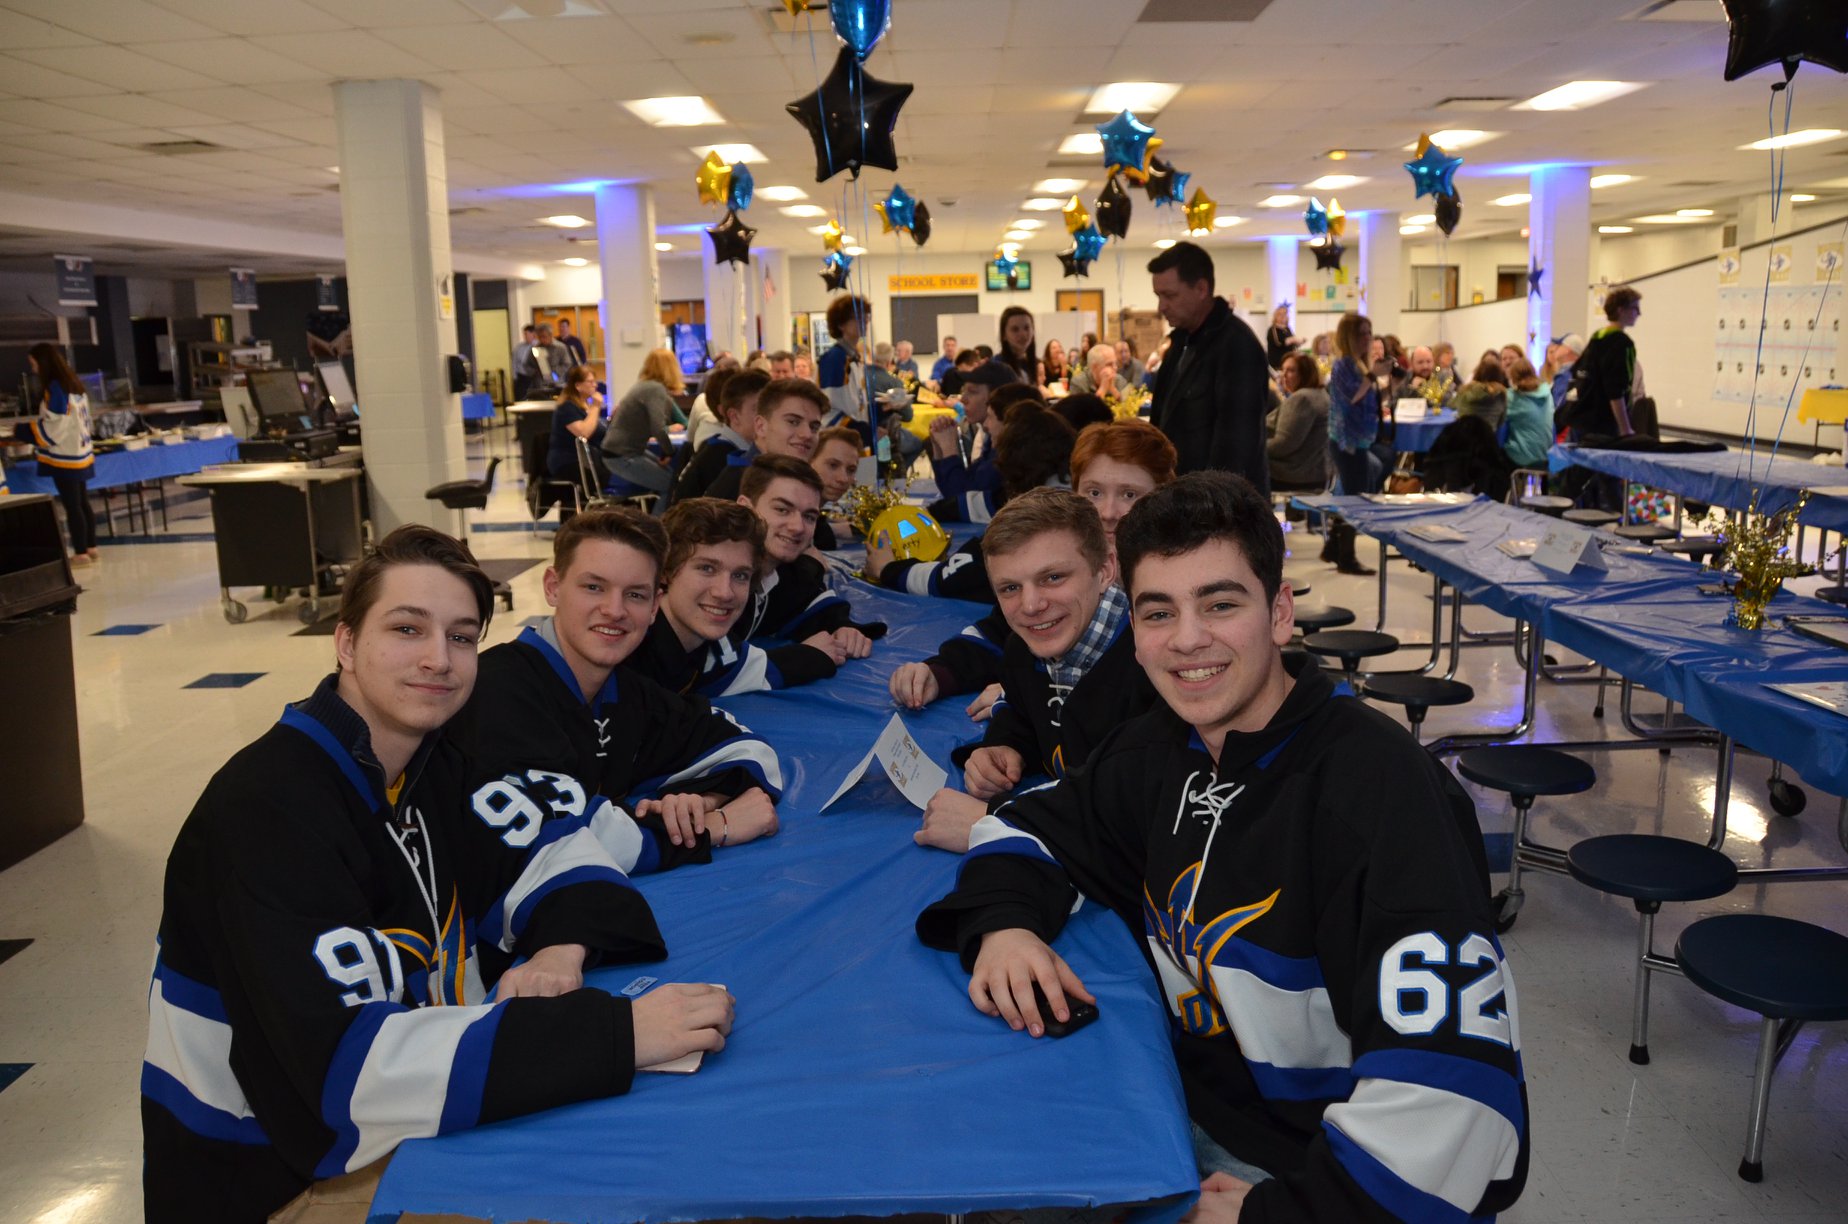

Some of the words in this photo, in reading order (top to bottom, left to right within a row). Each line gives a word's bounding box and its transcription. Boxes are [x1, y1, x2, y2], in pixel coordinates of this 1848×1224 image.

[890, 276, 935, 288] SCHOOL
[940, 275, 978, 287] STORE
[470, 769, 587, 848] 93
[1378, 931, 1512, 1048] 62
